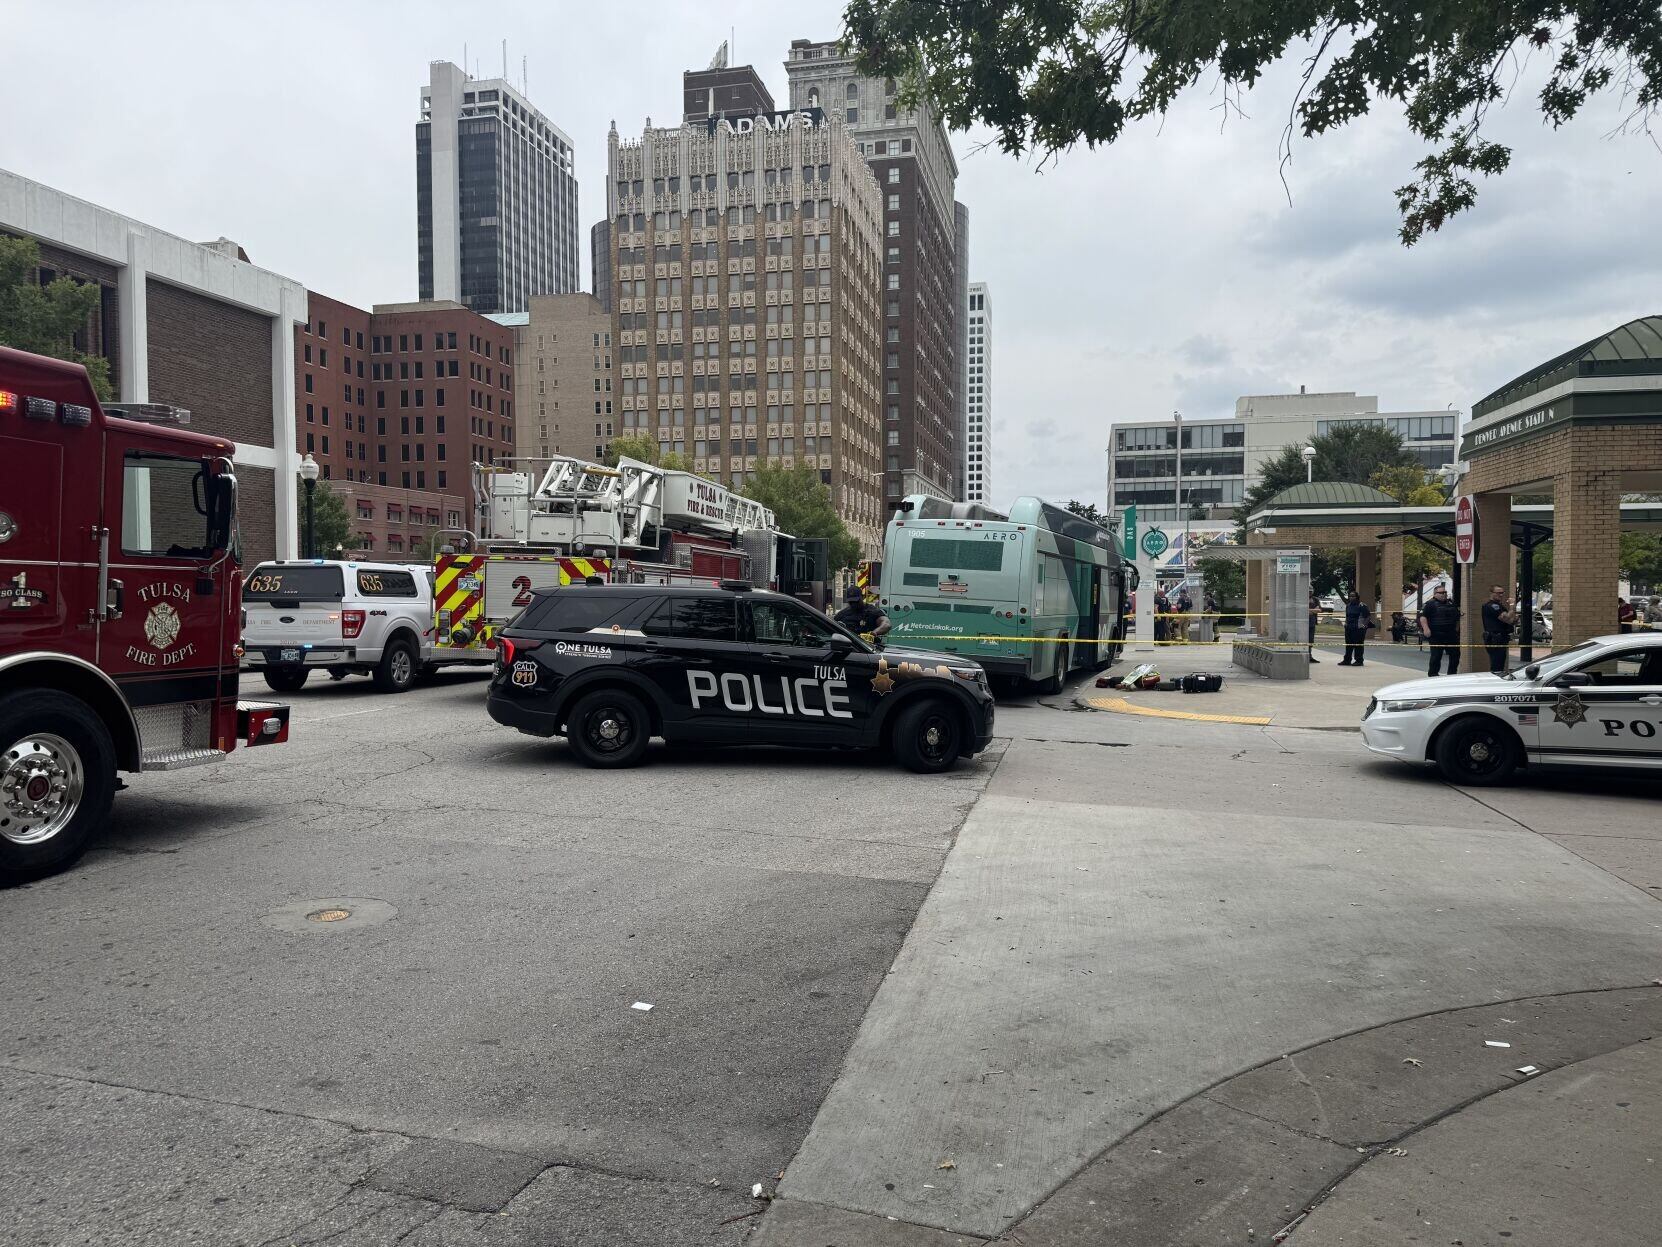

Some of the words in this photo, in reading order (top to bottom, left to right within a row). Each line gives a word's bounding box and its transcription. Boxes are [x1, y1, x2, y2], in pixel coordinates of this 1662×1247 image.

[1474, 428, 1498, 446] DENVER
[1499, 419, 1523, 437] AVENUE
[696, 483, 717, 504] TULSA
[687, 499, 700, 514] FIRE
[705, 504, 724, 519] RESCUE
[1457, 510, 1463, 520] DO
[1463, 508, 1471, 520] NOT
[907, 529, 926, 538] 1905
[983, 532, 1017, 541] AERO
[1459, 538, 1470, 550] ENTER
[250, 575, 283, 592] 635
[360, 574, 384, 591] 635
[15, 589, 43, 599] CLASS
[137, 582, 190, 604] TULSA
[511, 575, 532, 607] 2
[125, 645, 157, 666] FIRE
[162, 642, 197, 666] DEPT.
[555, 641, 581, 655] ONE
[583, 644, 613, 655] TULSA
[516, 662, 534, 671] CALL
[813, 665, 847, 681] TULSA
[515, 671, 533, 683] 911
[686, 669, 853, 719] POLICE
[1494, 695, 1537, 703] 2017071
[1598, 719, 1662, 738] PO
